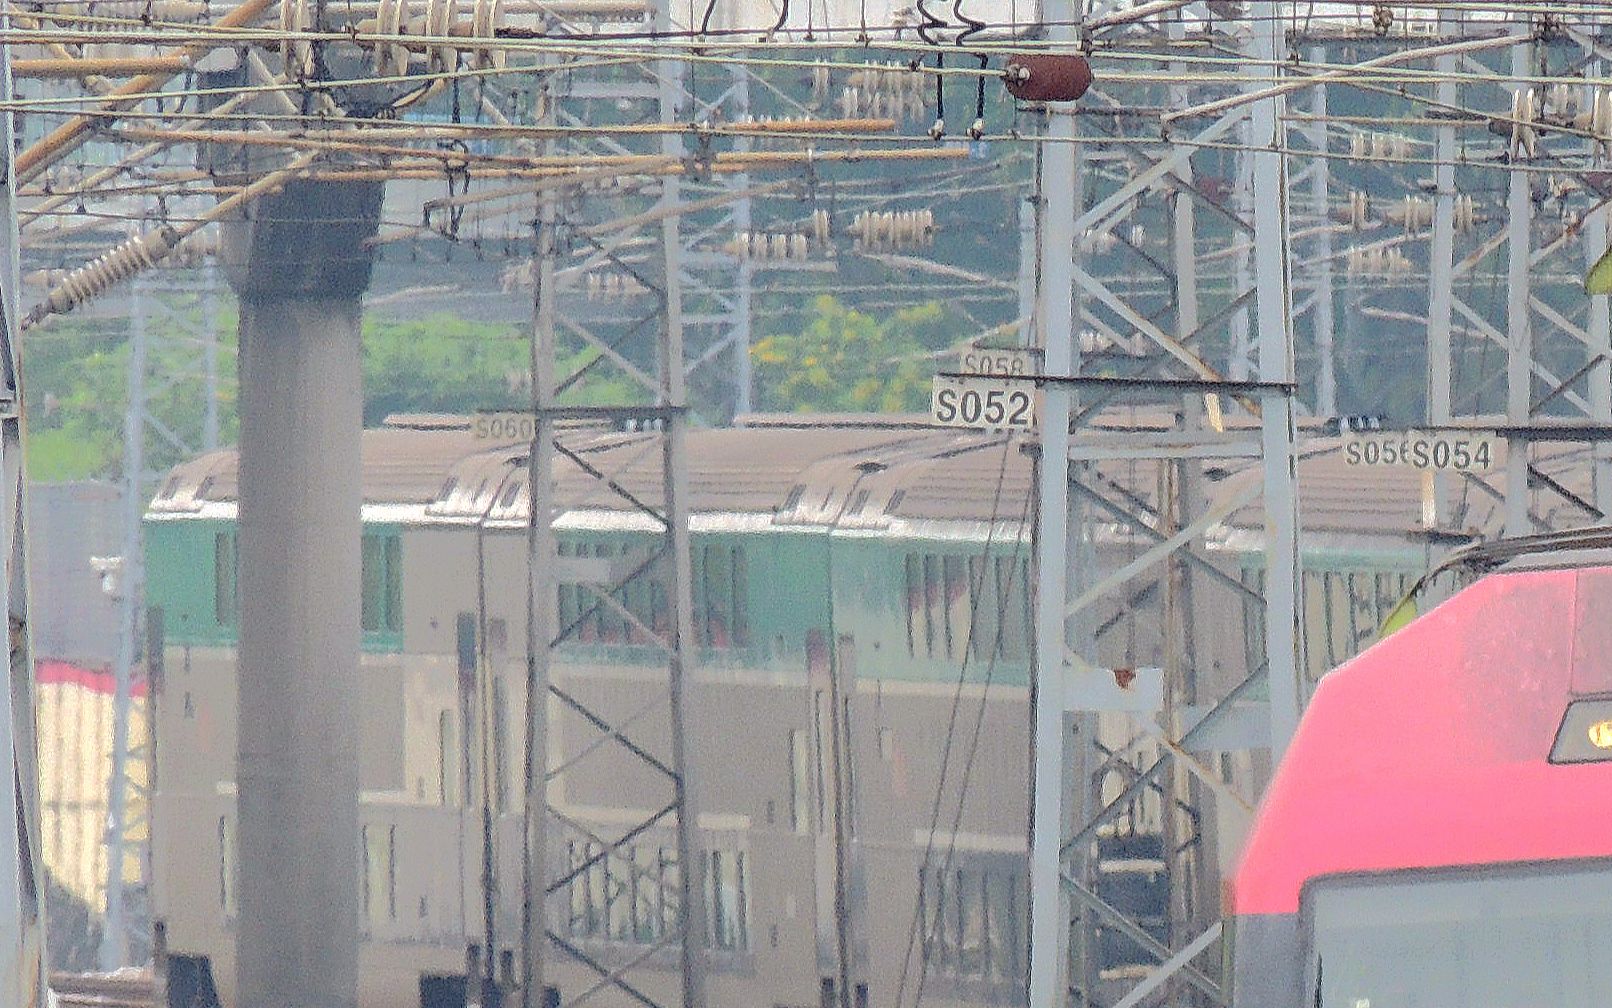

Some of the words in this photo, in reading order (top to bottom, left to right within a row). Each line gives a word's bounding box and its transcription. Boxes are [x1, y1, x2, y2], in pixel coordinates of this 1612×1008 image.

[936, 388, 1029, 424] S052
[477, 417, 532, 439] S060
[1412, 439, 1490, 469] S054
